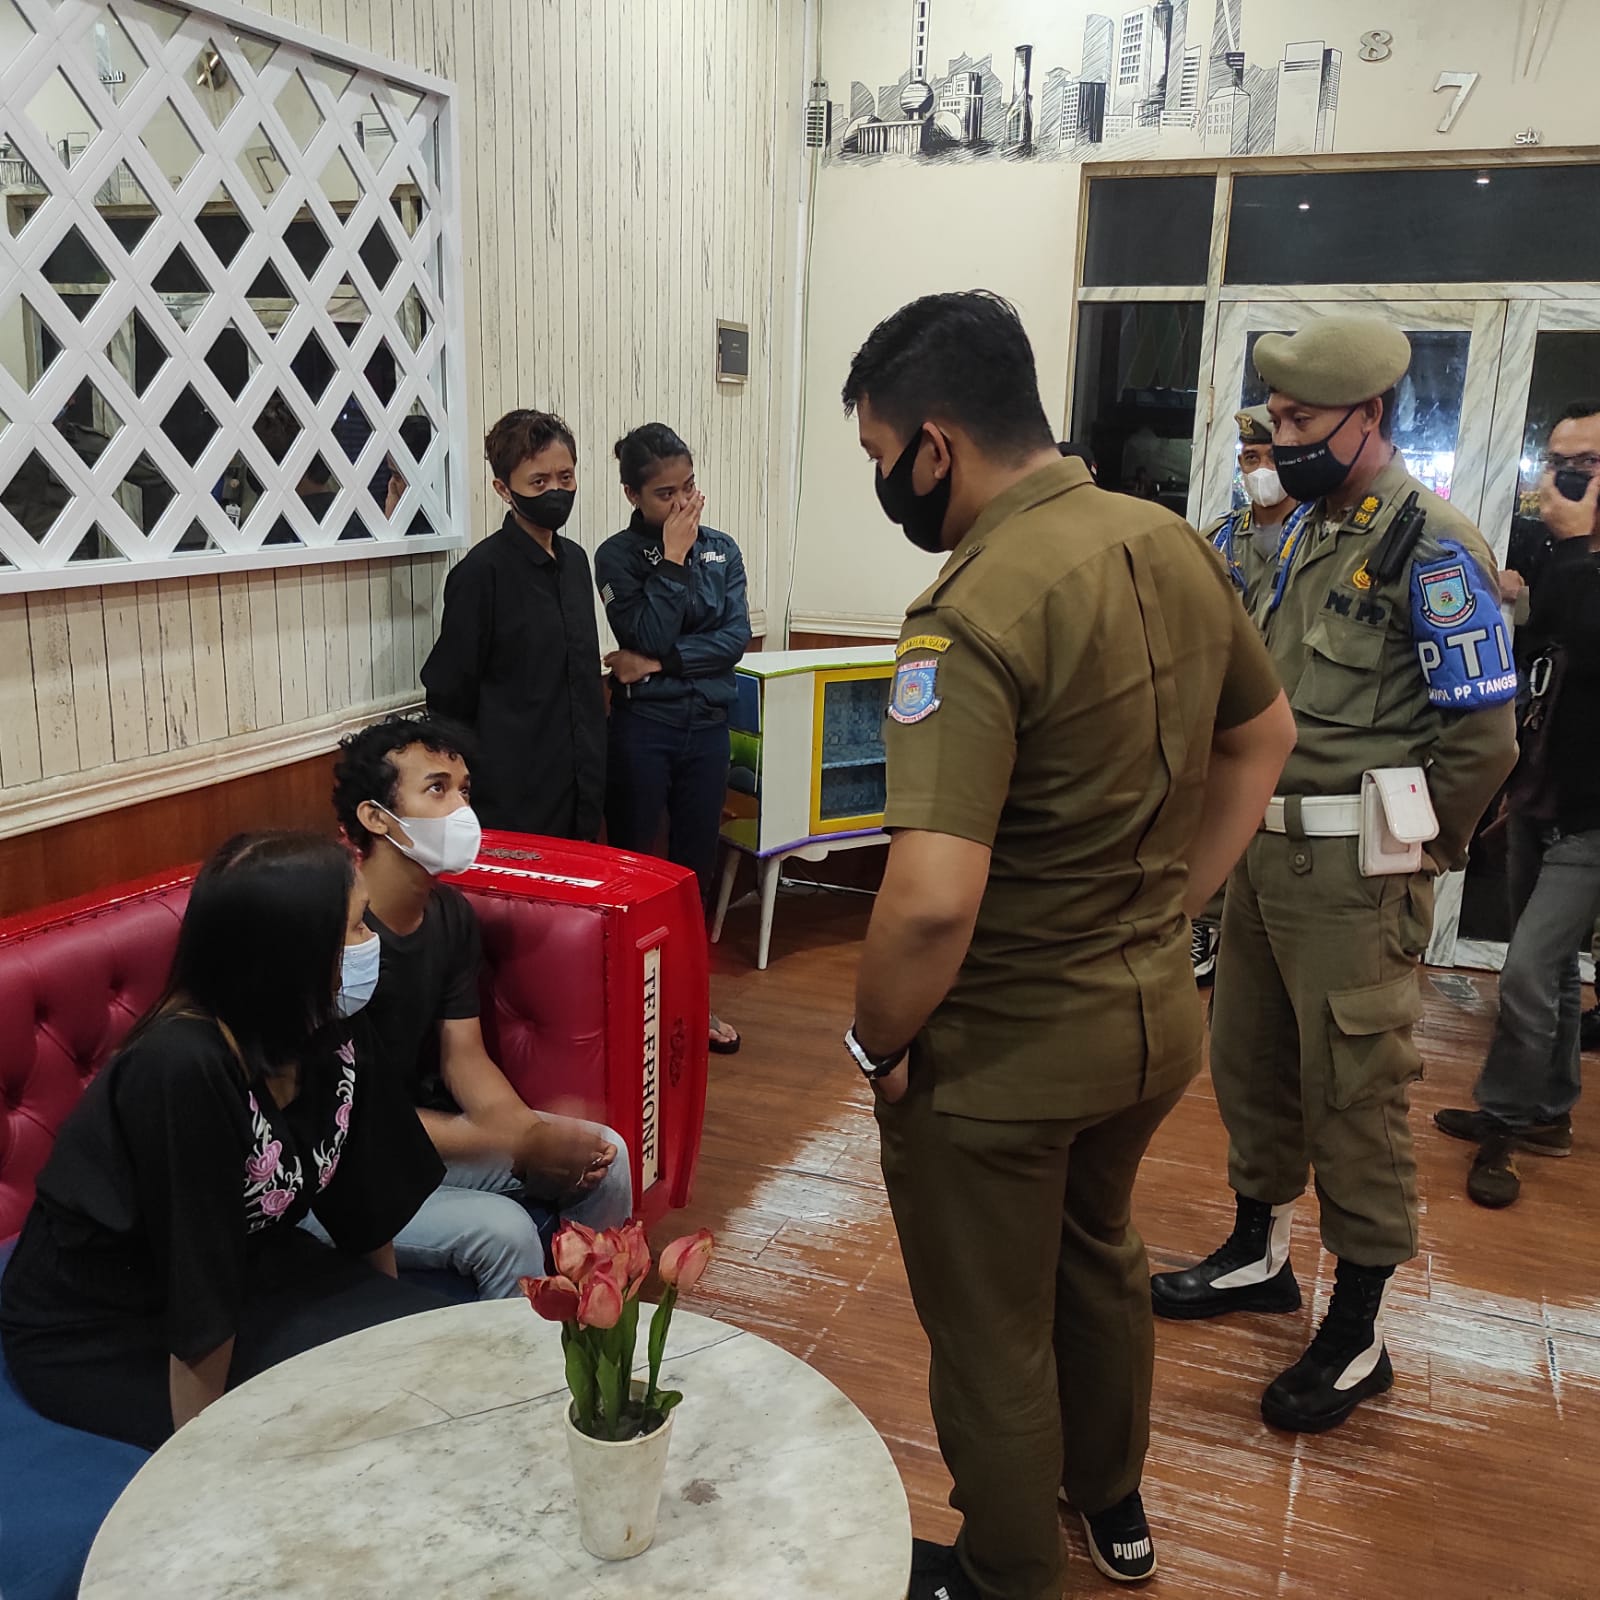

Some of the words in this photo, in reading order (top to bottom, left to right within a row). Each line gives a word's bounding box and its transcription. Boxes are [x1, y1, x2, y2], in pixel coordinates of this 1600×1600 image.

[1358, 30, 1393, 62] 8
[1432, 71, 1480, 133] 7
[1418, 624, 1511, 685] PTI
[1453, 684, 1473, 700] PP
[1112, 1536, 1151, 1560] PUMA
